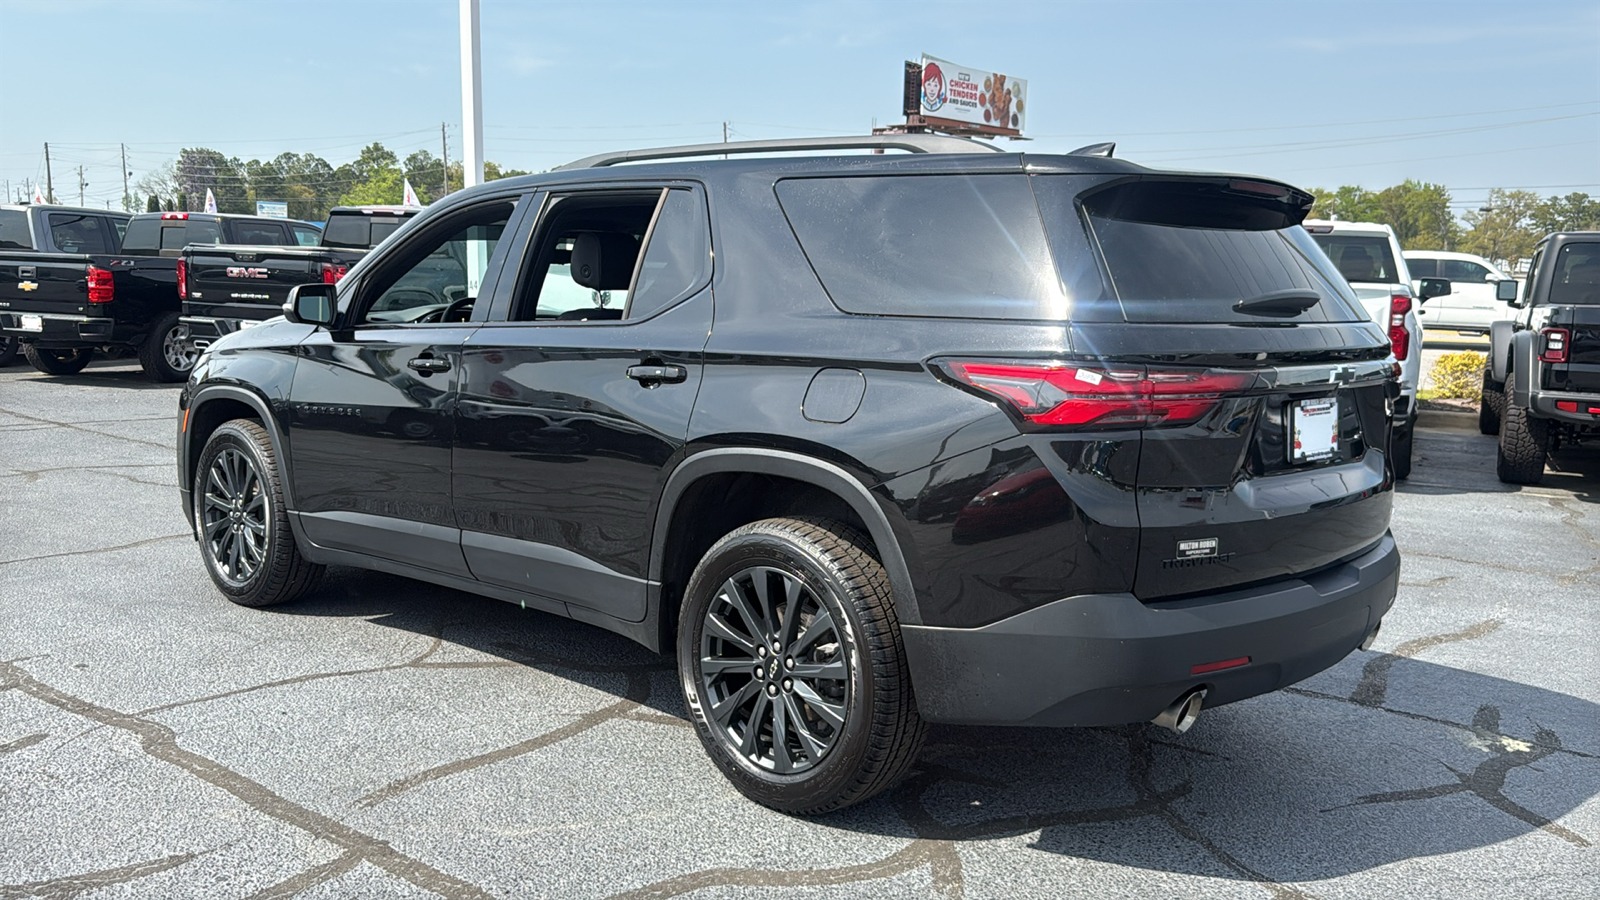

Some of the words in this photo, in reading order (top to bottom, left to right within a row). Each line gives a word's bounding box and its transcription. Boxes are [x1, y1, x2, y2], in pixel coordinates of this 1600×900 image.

[949, 79, 978, 92] CHICKEN
[949, 88, 978, 101] TENDERS
[960, 100, 978, 109] SAUCES
[226, 267, 268, 278] GMC
[469, 280, 478, 290] A4
[1179, 542, 1199, 551] MILTON
